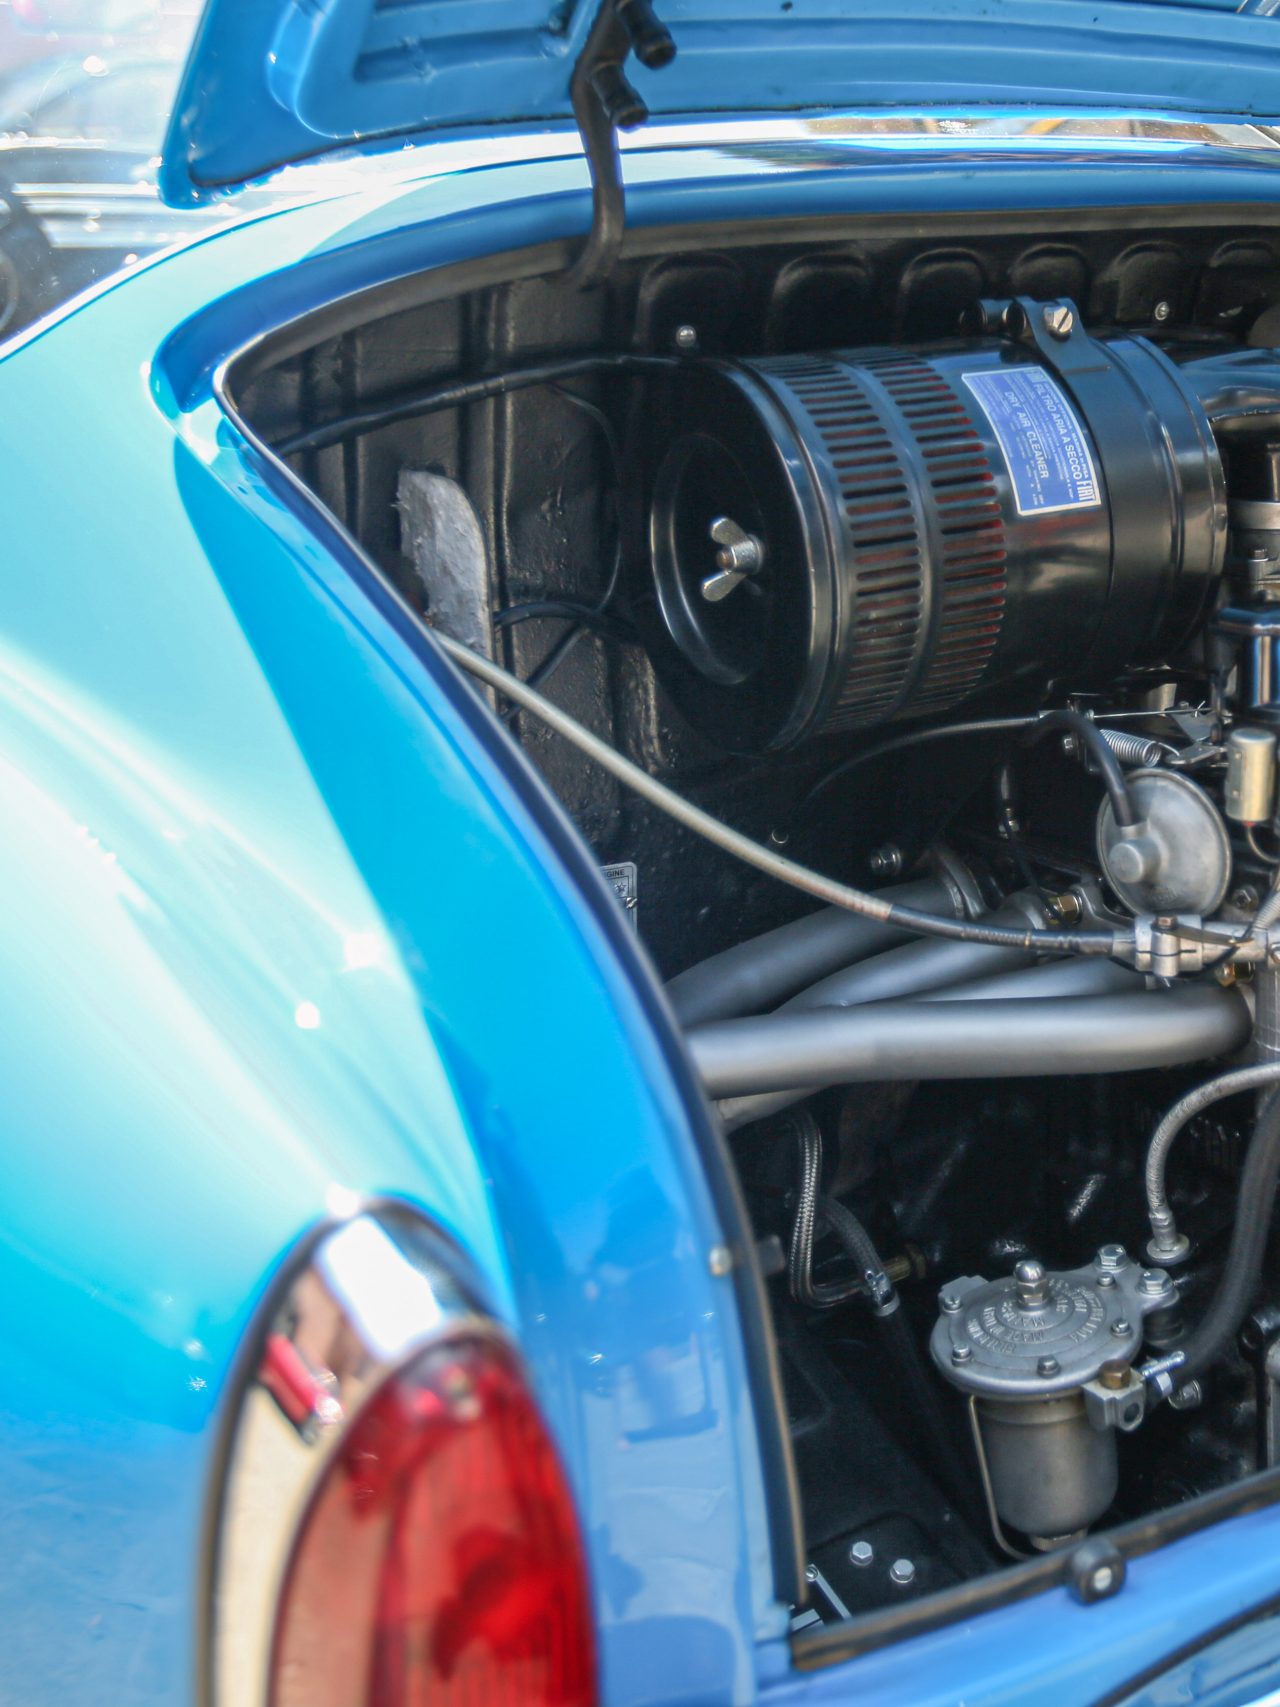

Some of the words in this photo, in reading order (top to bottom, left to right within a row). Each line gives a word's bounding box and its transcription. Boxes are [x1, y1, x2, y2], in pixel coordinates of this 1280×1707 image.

[1051, 411, 1067, 435] ARIA
[1004, 391, 1021, 408] DRY
[1016, 411, 1031, 428] AIR
[1026, 431, 1049, 479] CLEANER
[1062, 436, 1071, 444] A
[1065, 445, 1083, 480] SECCO
[1076, 480, 1096, 501] FIAT
[604, 869, 625, 878] GINE
